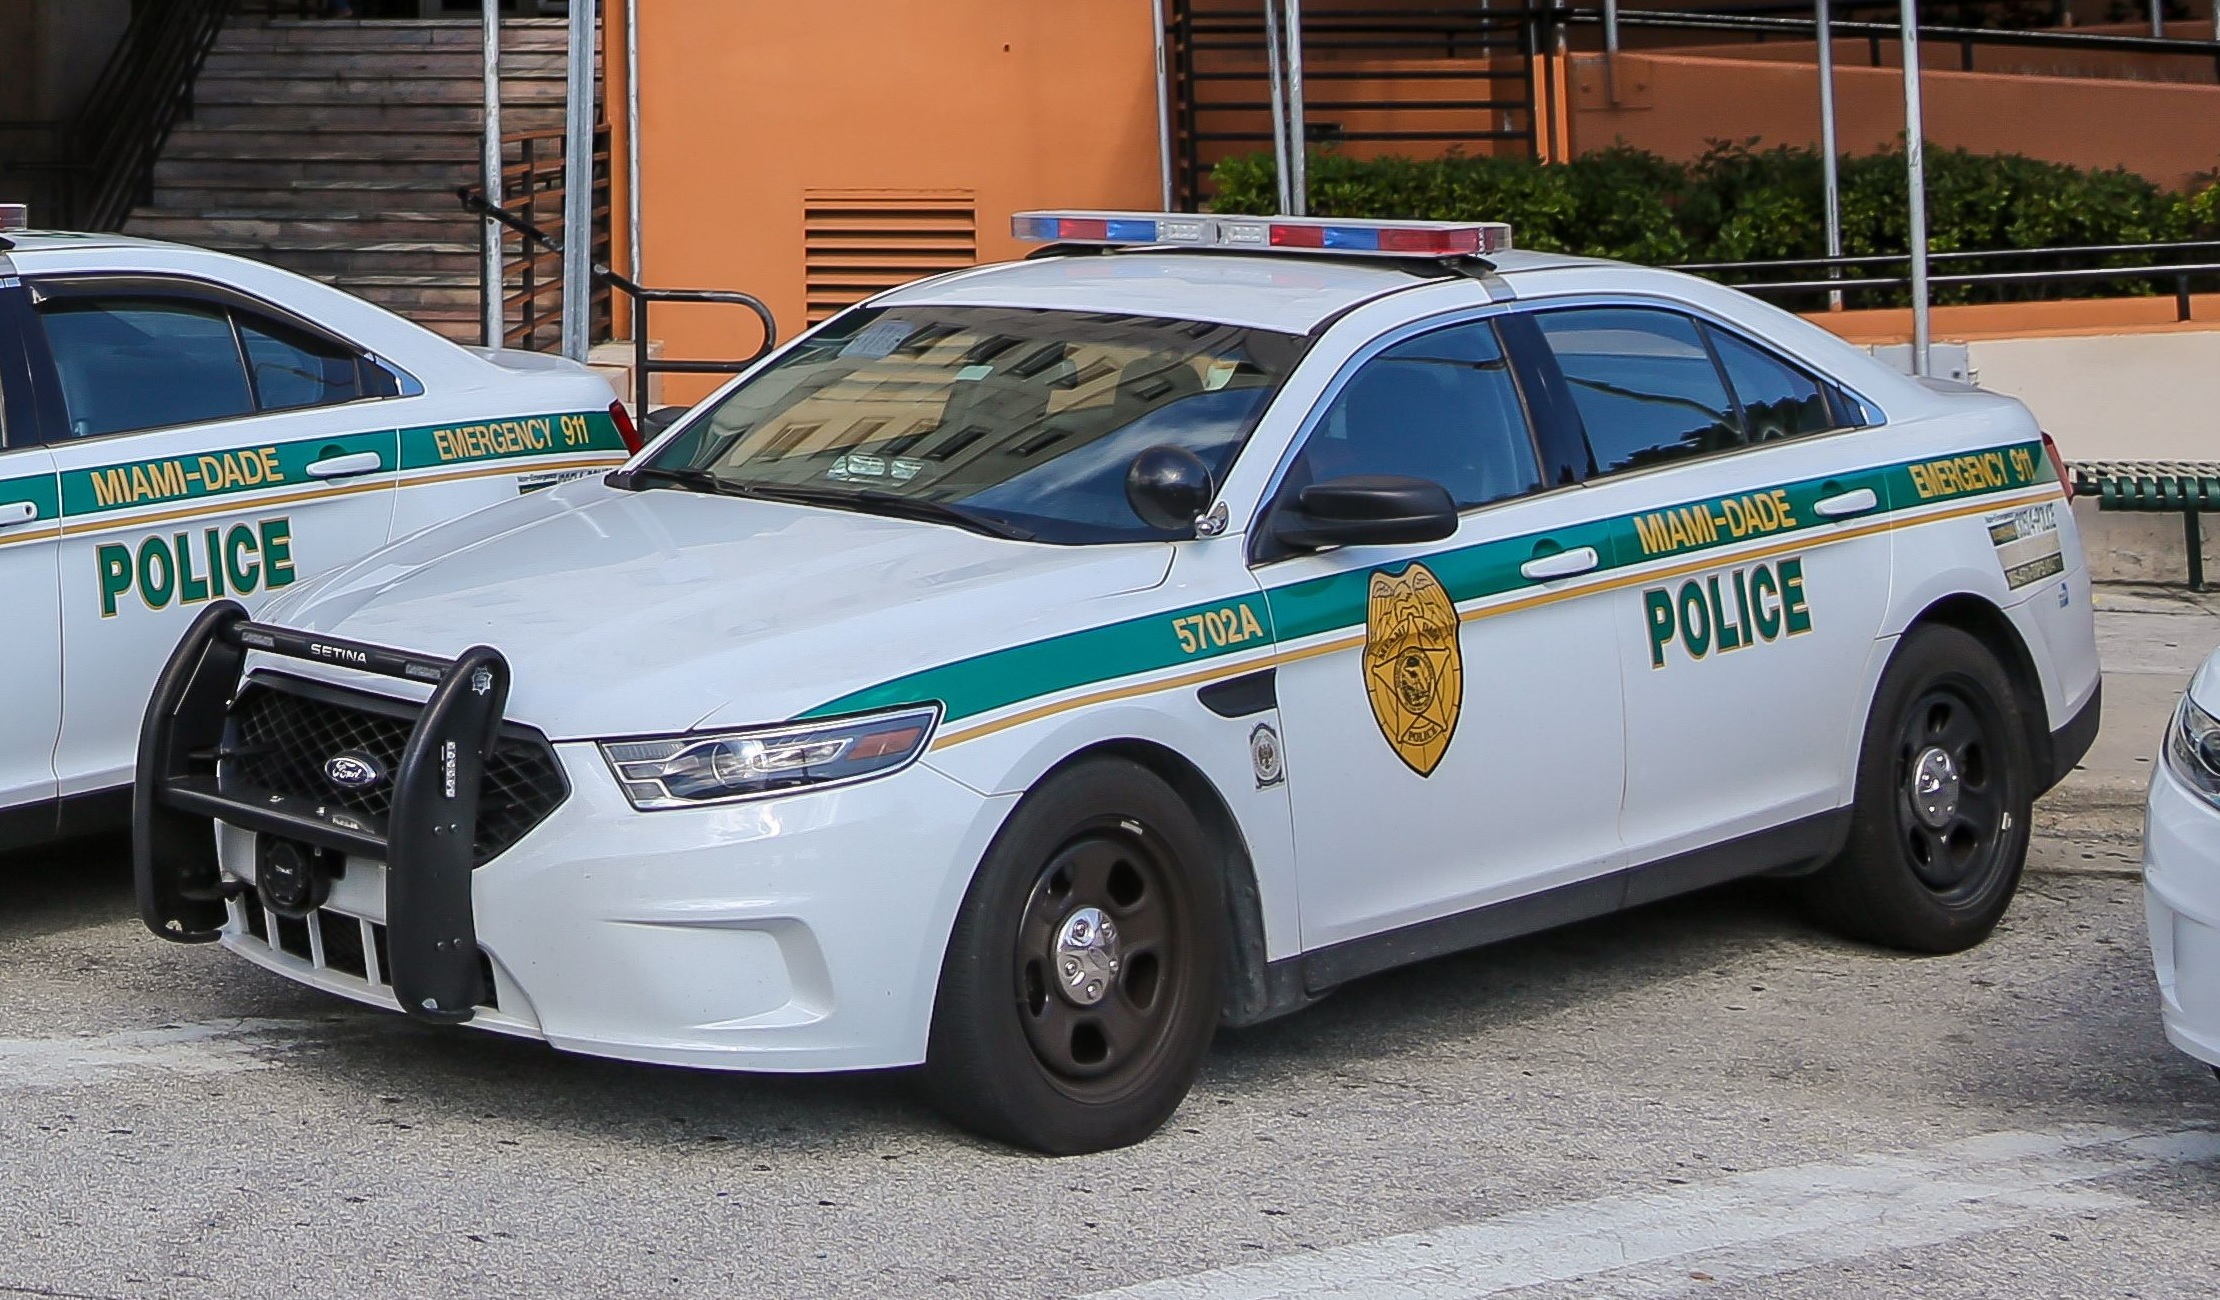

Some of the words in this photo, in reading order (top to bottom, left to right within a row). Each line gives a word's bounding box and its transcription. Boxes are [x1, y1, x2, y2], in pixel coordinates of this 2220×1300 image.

[434, 418, 553, 460] EMERGENCY
[562, 414, 590, 445] 911
[91, 447, 284, 506] MIAMI-DADE
[1908, 453, 2009, 498] EMERGENCY
[2010, 448, 2035, 484] 911
[1633, 490, 1797, 554] MIAMI-DADE
[96, 515, 297, 618] POLICE
[1172, 603, 1263, 653] 5702A
[1643, 556, 1812, 669] POLICE
[310, 643, 367, 664] SETINA
[1407, 726, 1438, 741] POLICE
[332, 761, 362, 779] Ford
